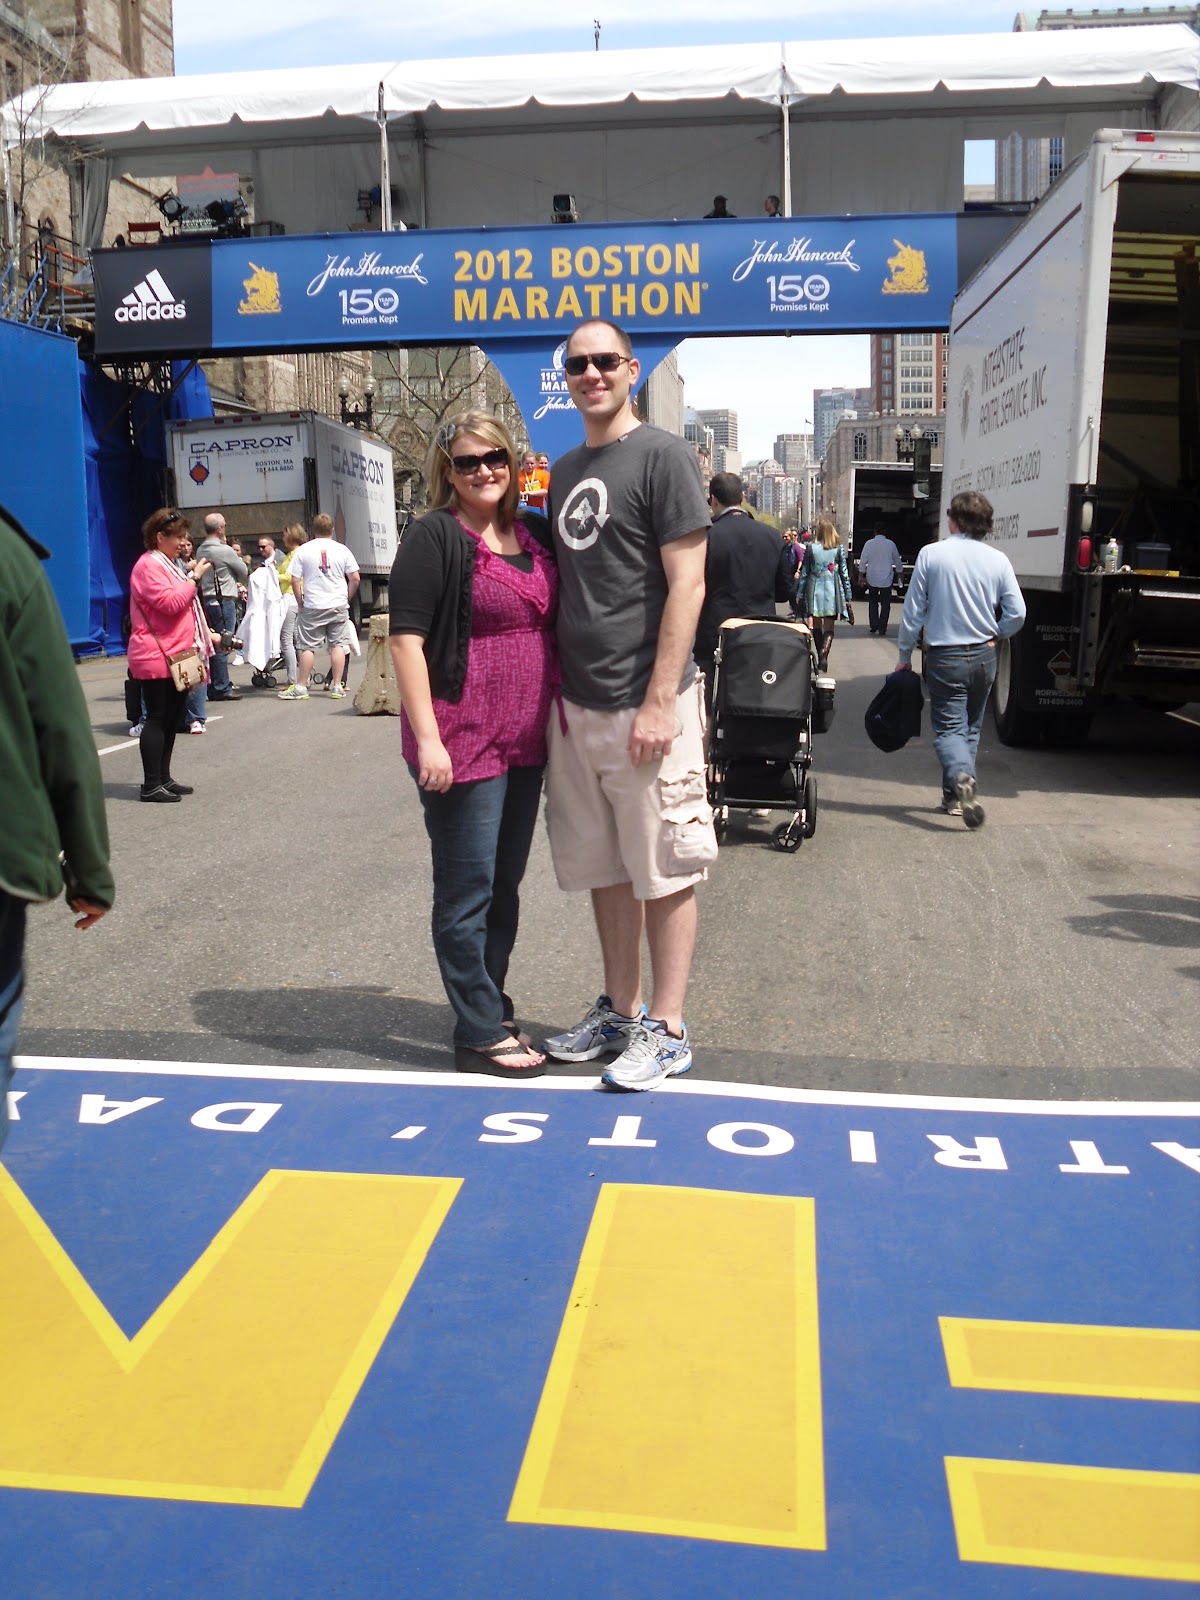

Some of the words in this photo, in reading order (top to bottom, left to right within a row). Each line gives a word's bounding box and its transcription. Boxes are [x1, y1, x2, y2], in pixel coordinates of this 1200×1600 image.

[306, 254, 356, 296] John
[454, 248, 533, 282] 2012
[551, 243, 699, 279] BOSTON
[733, 239, 783, 282] John
[338, 287, 400, 316] 150
[454, 281, 701, 322] MARATHON
[767, 274, 831, 302] 150
[114, 301, 187, 322] adidas
[342, 315, 378, 325] Promises
[379, 315, 399, 325] Kept
[770, 302, 808, 312] Promises
[809, 301, 830, 312] Kept
[981, 326, 1026, 395] INTERSTATE
[541, 381, 569, 391] MAR
[190, 435, 294, 454] CAPRON
[331, 443, 385, 486] CAPRON
[1011, 449, 1041, 486] 522-6200
